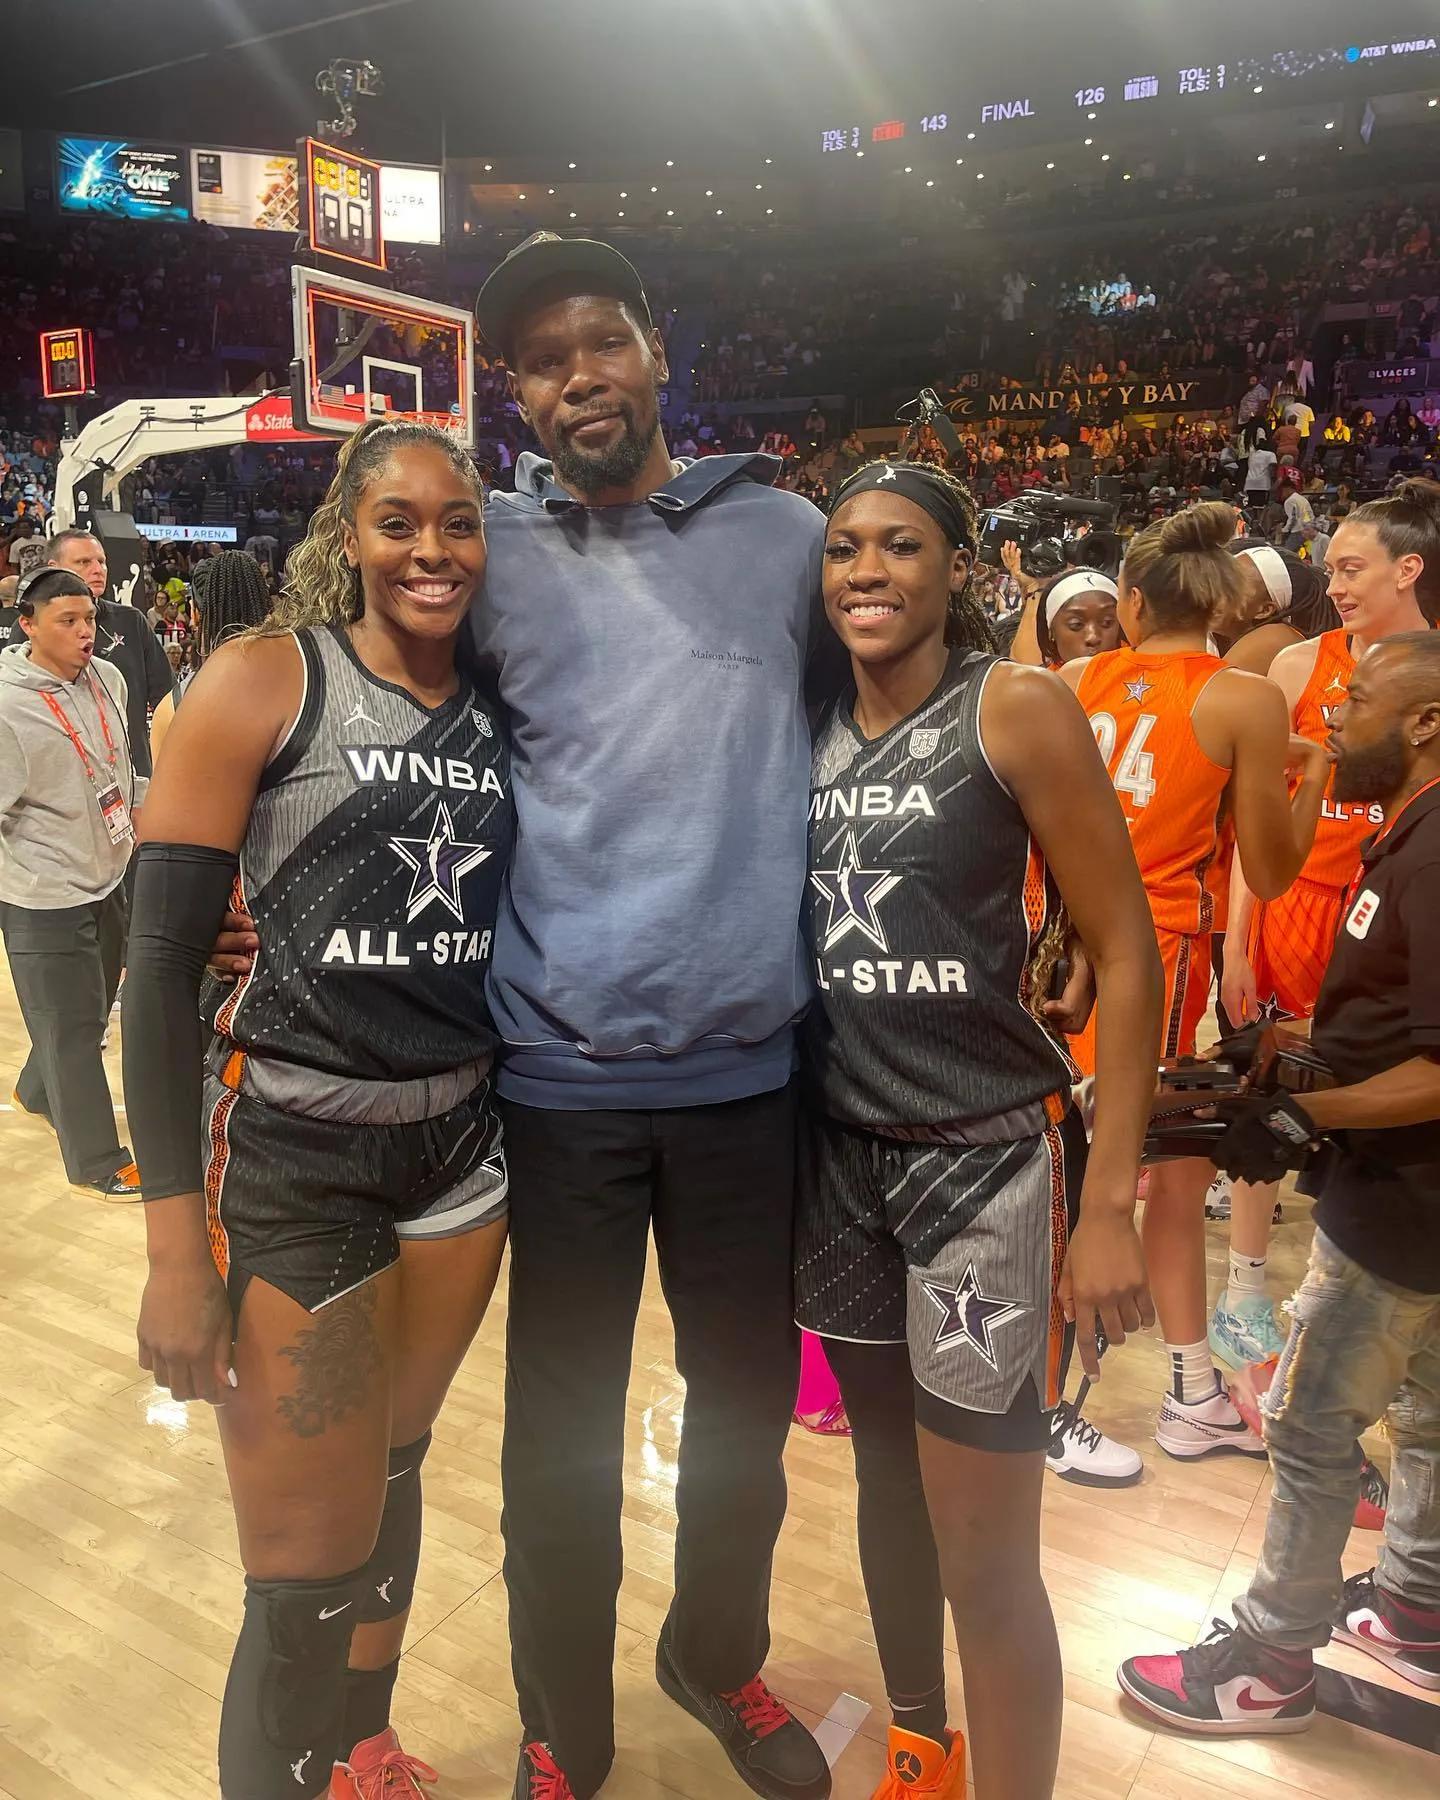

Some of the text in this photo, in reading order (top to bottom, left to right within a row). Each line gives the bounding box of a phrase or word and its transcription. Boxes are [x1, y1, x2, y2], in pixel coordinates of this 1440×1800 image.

[1360, 39, 1437, 58] AT&T WNBA
[1179, 64, 1226, 82] TOL: 3
[1179, 76, 1225, 94] FLS: 1
[1075, 87, 1105, 106] 126
[981, 99, 1035, 123] FINAL
[920, 114, 948, 132] 143
[822, 130, 848, 142] TOL:
[852, 127, 860, 138] 3
[822, 137, 860, 152] FLS: 4
[127, 174, 170, 192] ONE
[384, 195, 425, 206] ULTRA
[1142, 382, 1194, 404] BAY
[264, 413, 294, 431] State
[144, 528, 229, 539] ULTRA ARENA
[690, 648, 724, 661] Maison
[346, 750, 505, 800] WNBA
[808, 784, 937, 822] WNBA
[320, 928, 492, 967] ALL-STAR
[816, 957, 968, 994] L-STAR
